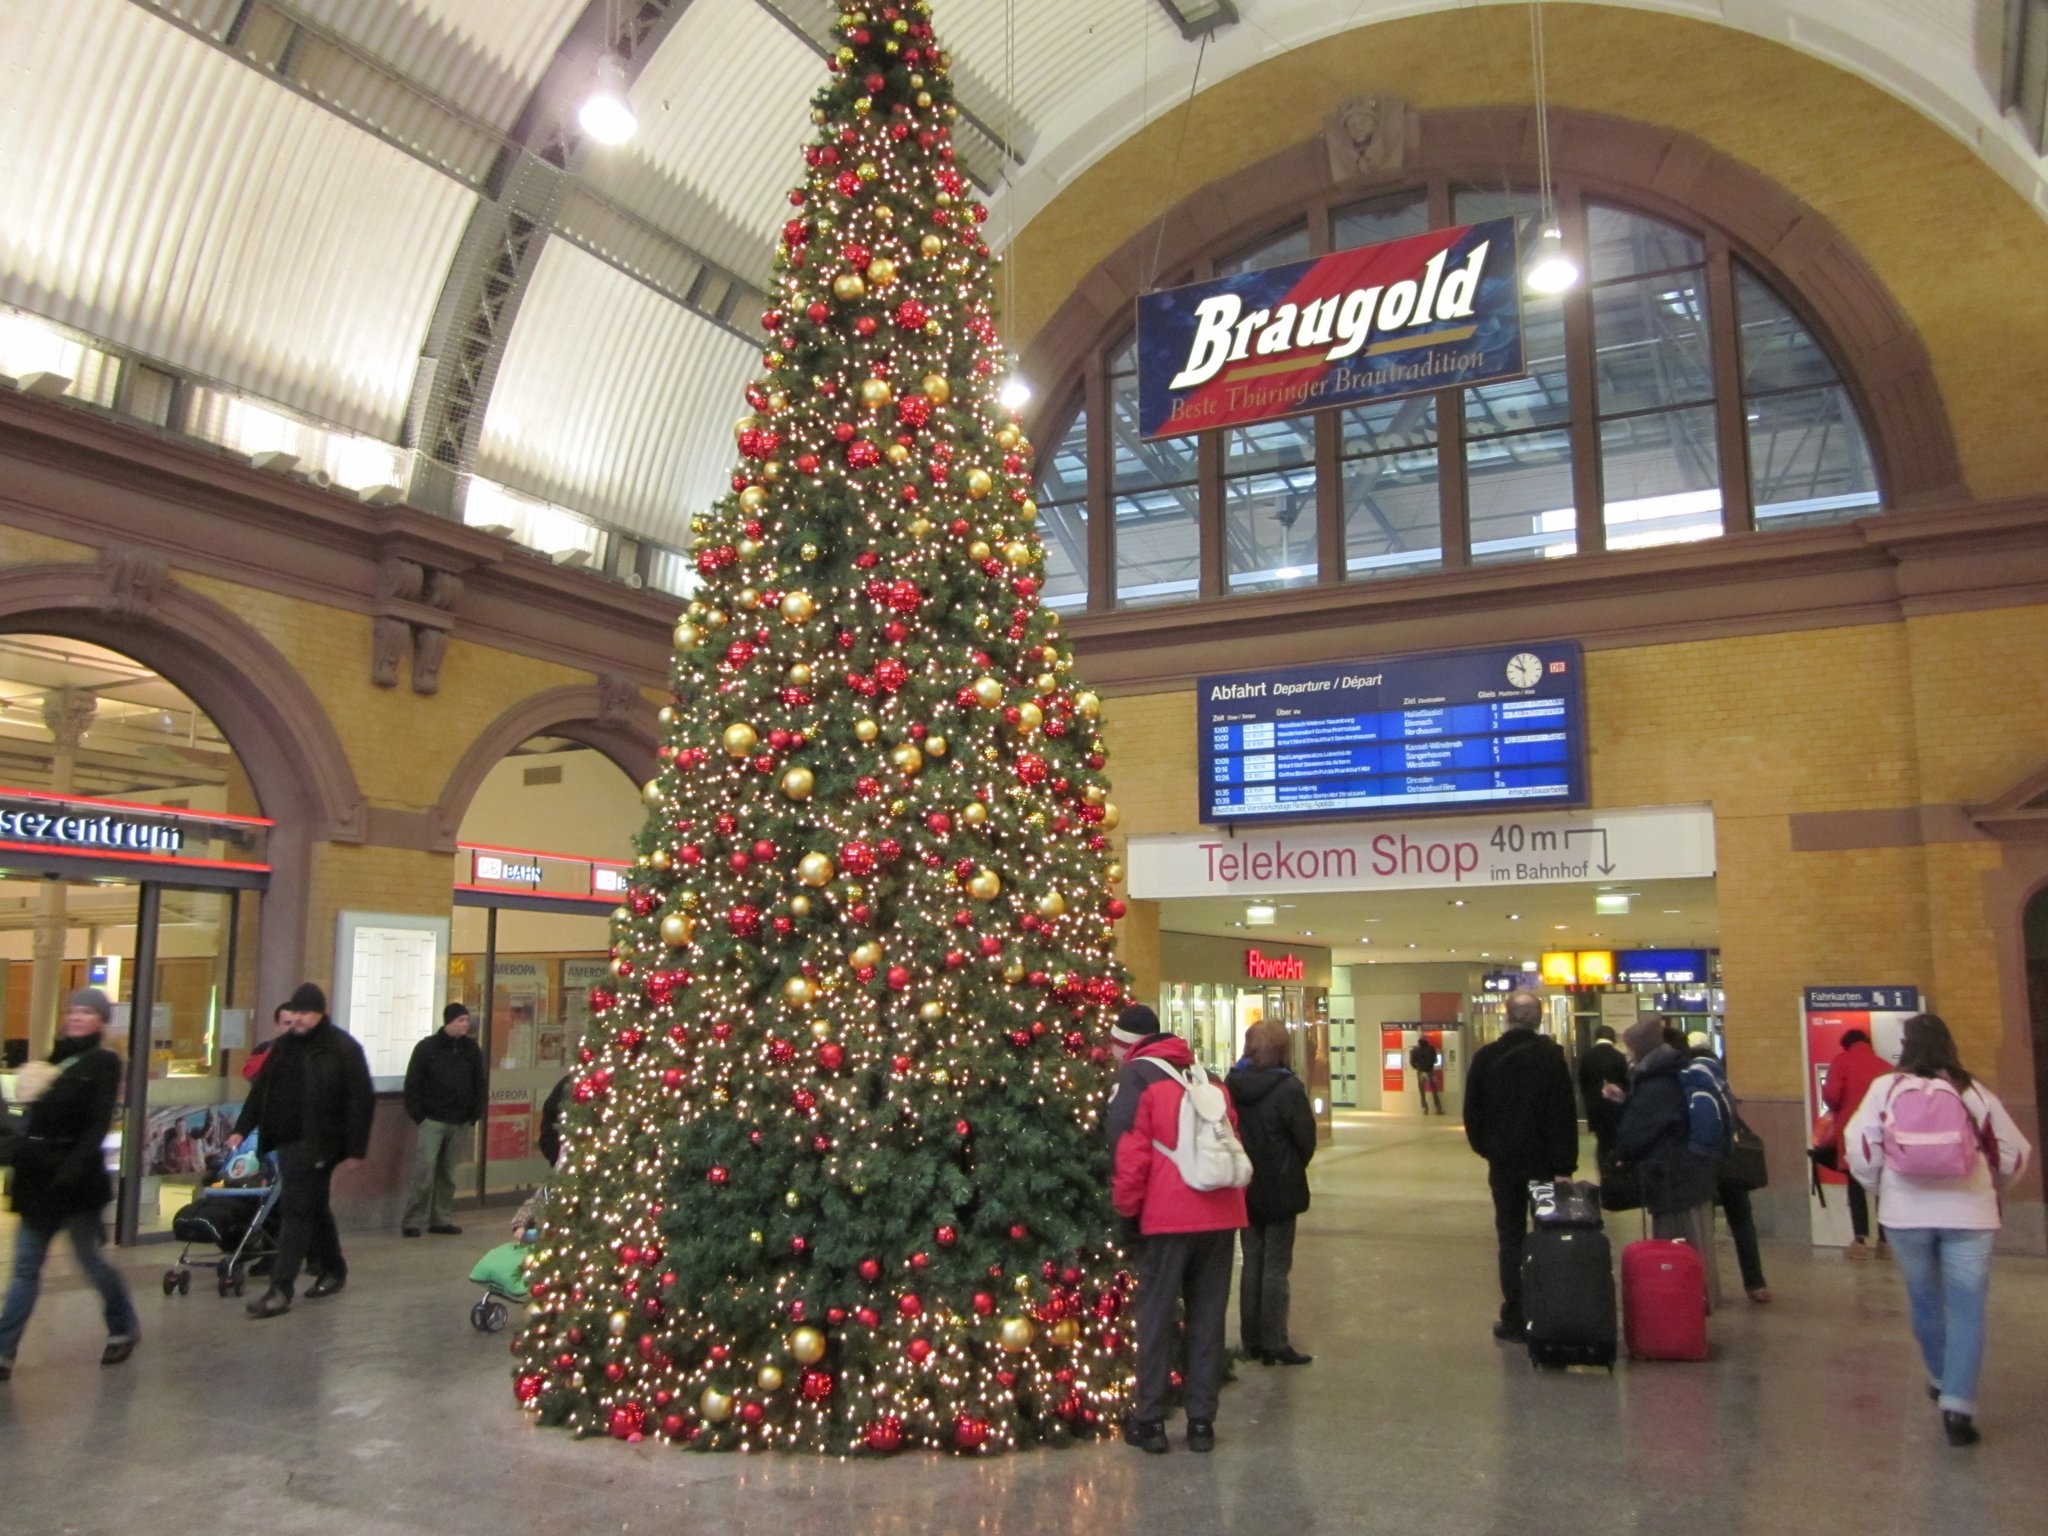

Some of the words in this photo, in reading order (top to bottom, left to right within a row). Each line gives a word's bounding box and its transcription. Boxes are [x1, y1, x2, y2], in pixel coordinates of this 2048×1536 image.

[1168, 240, 1489, 390] Braugold
[1171, 397, 1218, 420] Beste
[1225, 379, 1329, 411] Thüringer
[1336, 350, 1484, 392] Brautradition
[1551, 662, 1564, 672] DB
[1211, 682, 1267, 700] Abfahrt
[1273, 680, 1330, 696] Departure
[1342, 674, 1383, 690] Départ
[1478, 690, 1496, 698] Gleis
[1277, 708, 1291, 716] Über
[0, 809, 185, 850] sezentrum
[1490, 824, 1524, 852] 40
[1531, 830, 1556, 851] m
[479, 858, 500, 878] DB
[503, 863, 542, 882] BAHN
[1199, 840, 1356, 882] Telekom
[1372, 833, 1479, 882] Shop
[1491, 864, 1510, 881] im
[1516, 860, 1588, 880] Bahnhof
[1247, 949, 1303, 980] FlowerArt
[1811, 992, 1861, 1001] Fahrkarten
